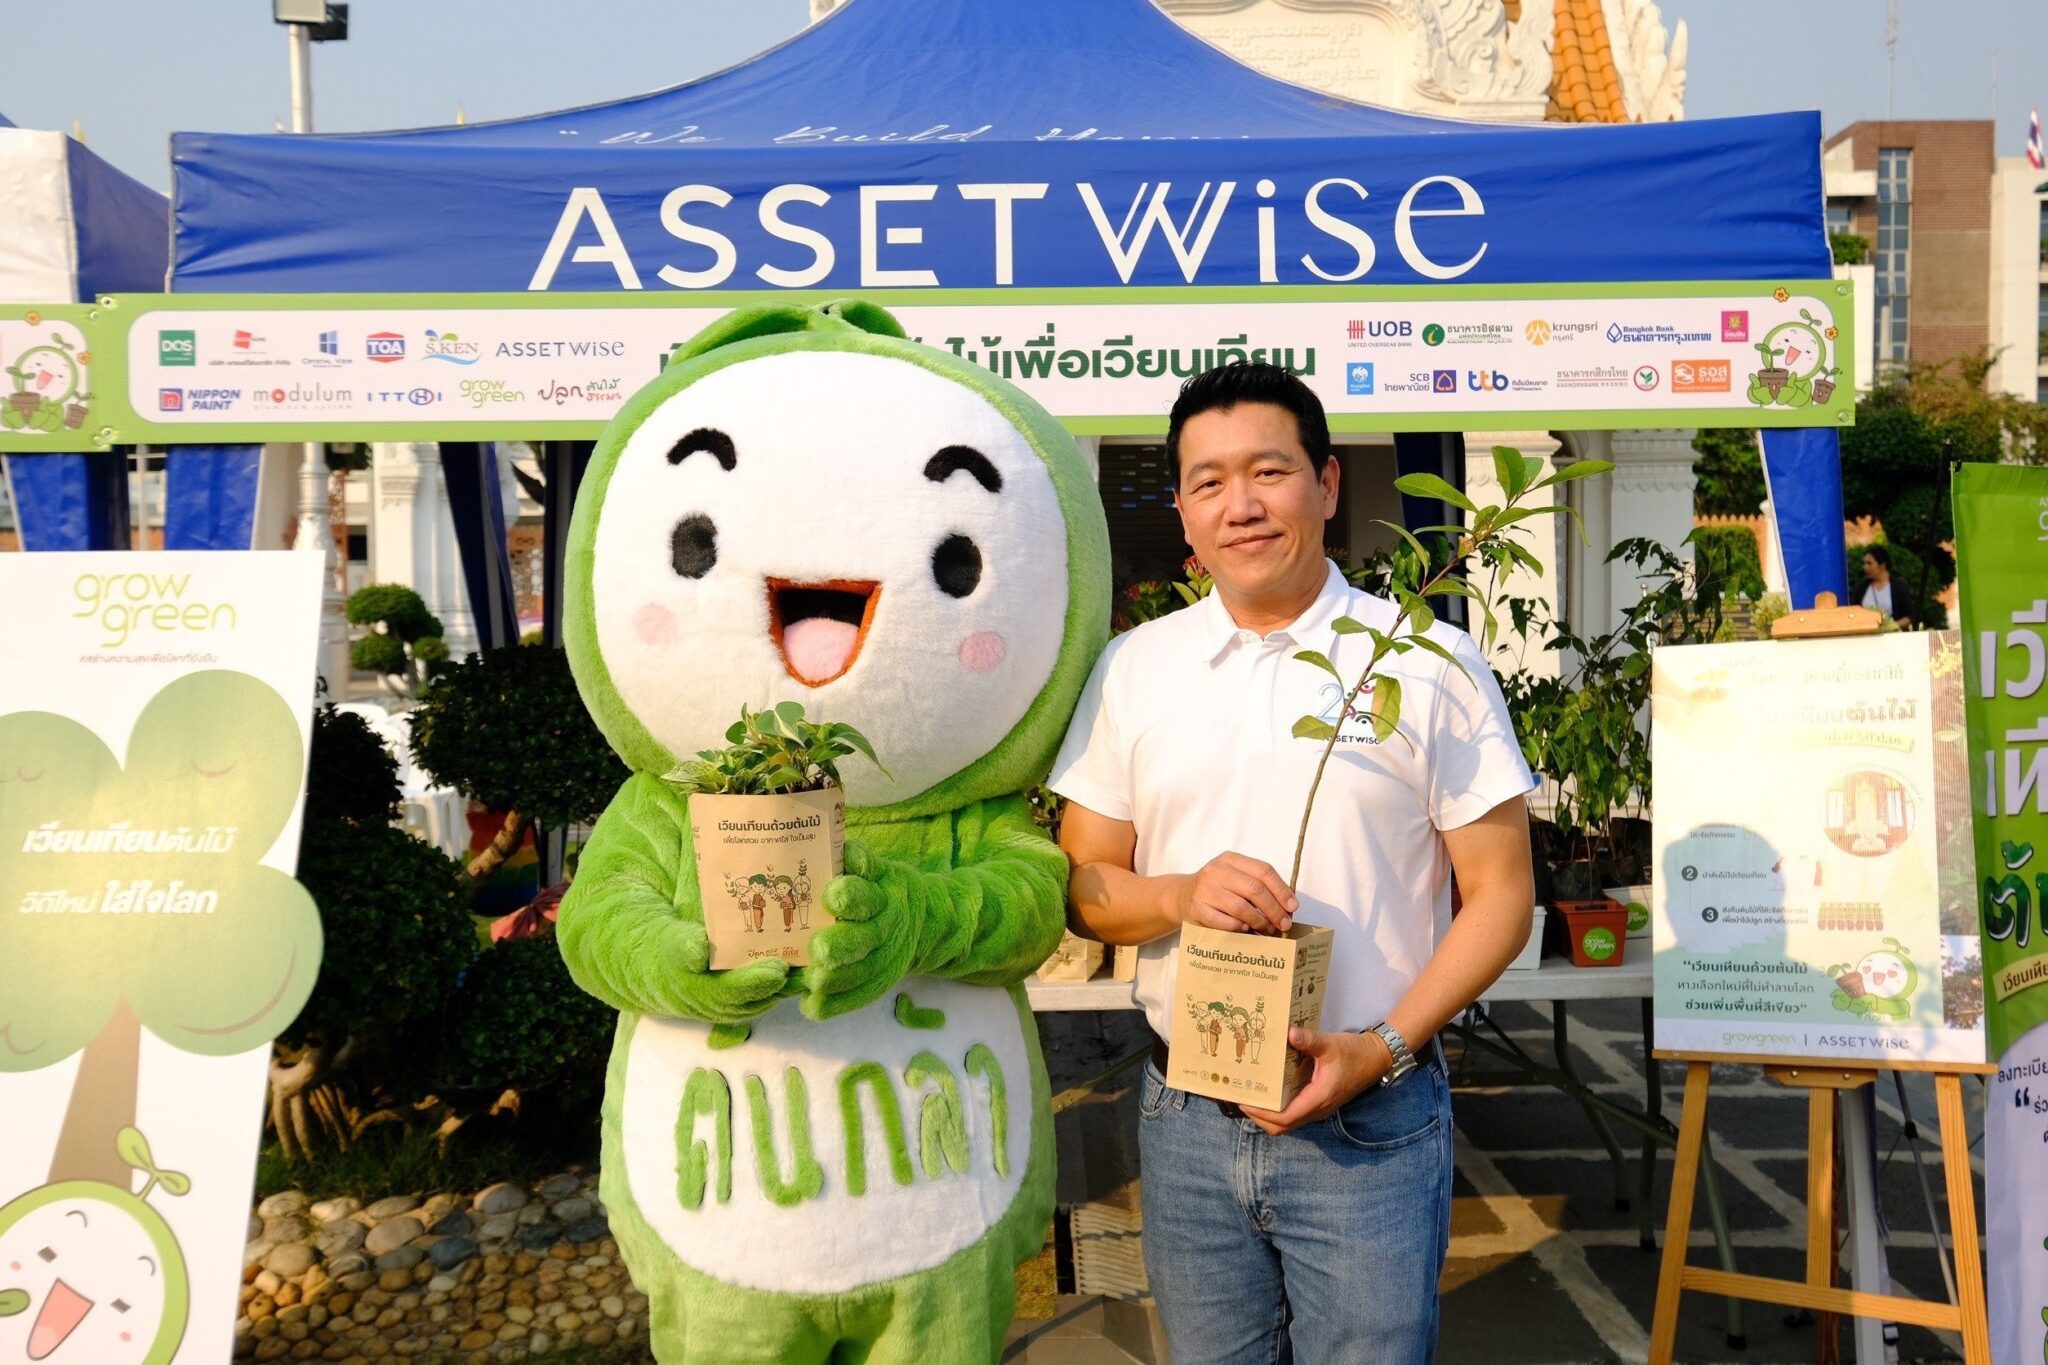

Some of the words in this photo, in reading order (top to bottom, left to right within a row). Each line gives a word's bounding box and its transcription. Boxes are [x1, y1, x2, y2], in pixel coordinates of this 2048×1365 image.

[773, 124, 993, 143] Build
[1368, 320, 1412, 337] UOB
[1447, 323, 1513, 333] ธนาคารอิสลาม
[1553, 320, 1598, 334] krungsri
[1623, 325, 1654, 334] Bangkok
[161, 339, 193, 352] DOS
[1553, 334, 1574, 342] กรุงศรี
[1623, 333, 1711, 345] ธนาคารกรุงเทพ
[367, 340, 404, 355] TOA
[424, 341, 480, 355] S.KEN
[1409, 373, 1430, 382] SCB
[1468, 369, 1509, 391] ttb
[1556, 366, 1628, 378] ธนาคารกสิกรไทย
[187, 389, 241, 399] NIPPON
[253, 382, 353, 403] modulum
[460, 379, 506, 398] grow
[538, 379, 584, 406] ปลูก
[1384, 382, 1430, 392] ไทยพาณิชย์
[367, 388, 443, 405] ITTHI
[473, 389, 525, 409] green
[192, 400, 232, 410] PAINT
[73, 572, 191, 618] grow
[101, 602, 236, 648] green
[718, 814, 821, 832] เวียนเทียนด้วยต้นไม้
[21, 820, 239, 854] เวียนเทียนต้นไม้
[100, 878, 219, 914] ใส่ใจโลก
[1187, 944, 1286, 970] เวียนเทียนด้วยต้นไม้
[1677, 978, 1815, 994] ทางเลือกใหม่ที่ไม่ทำลายโลก
